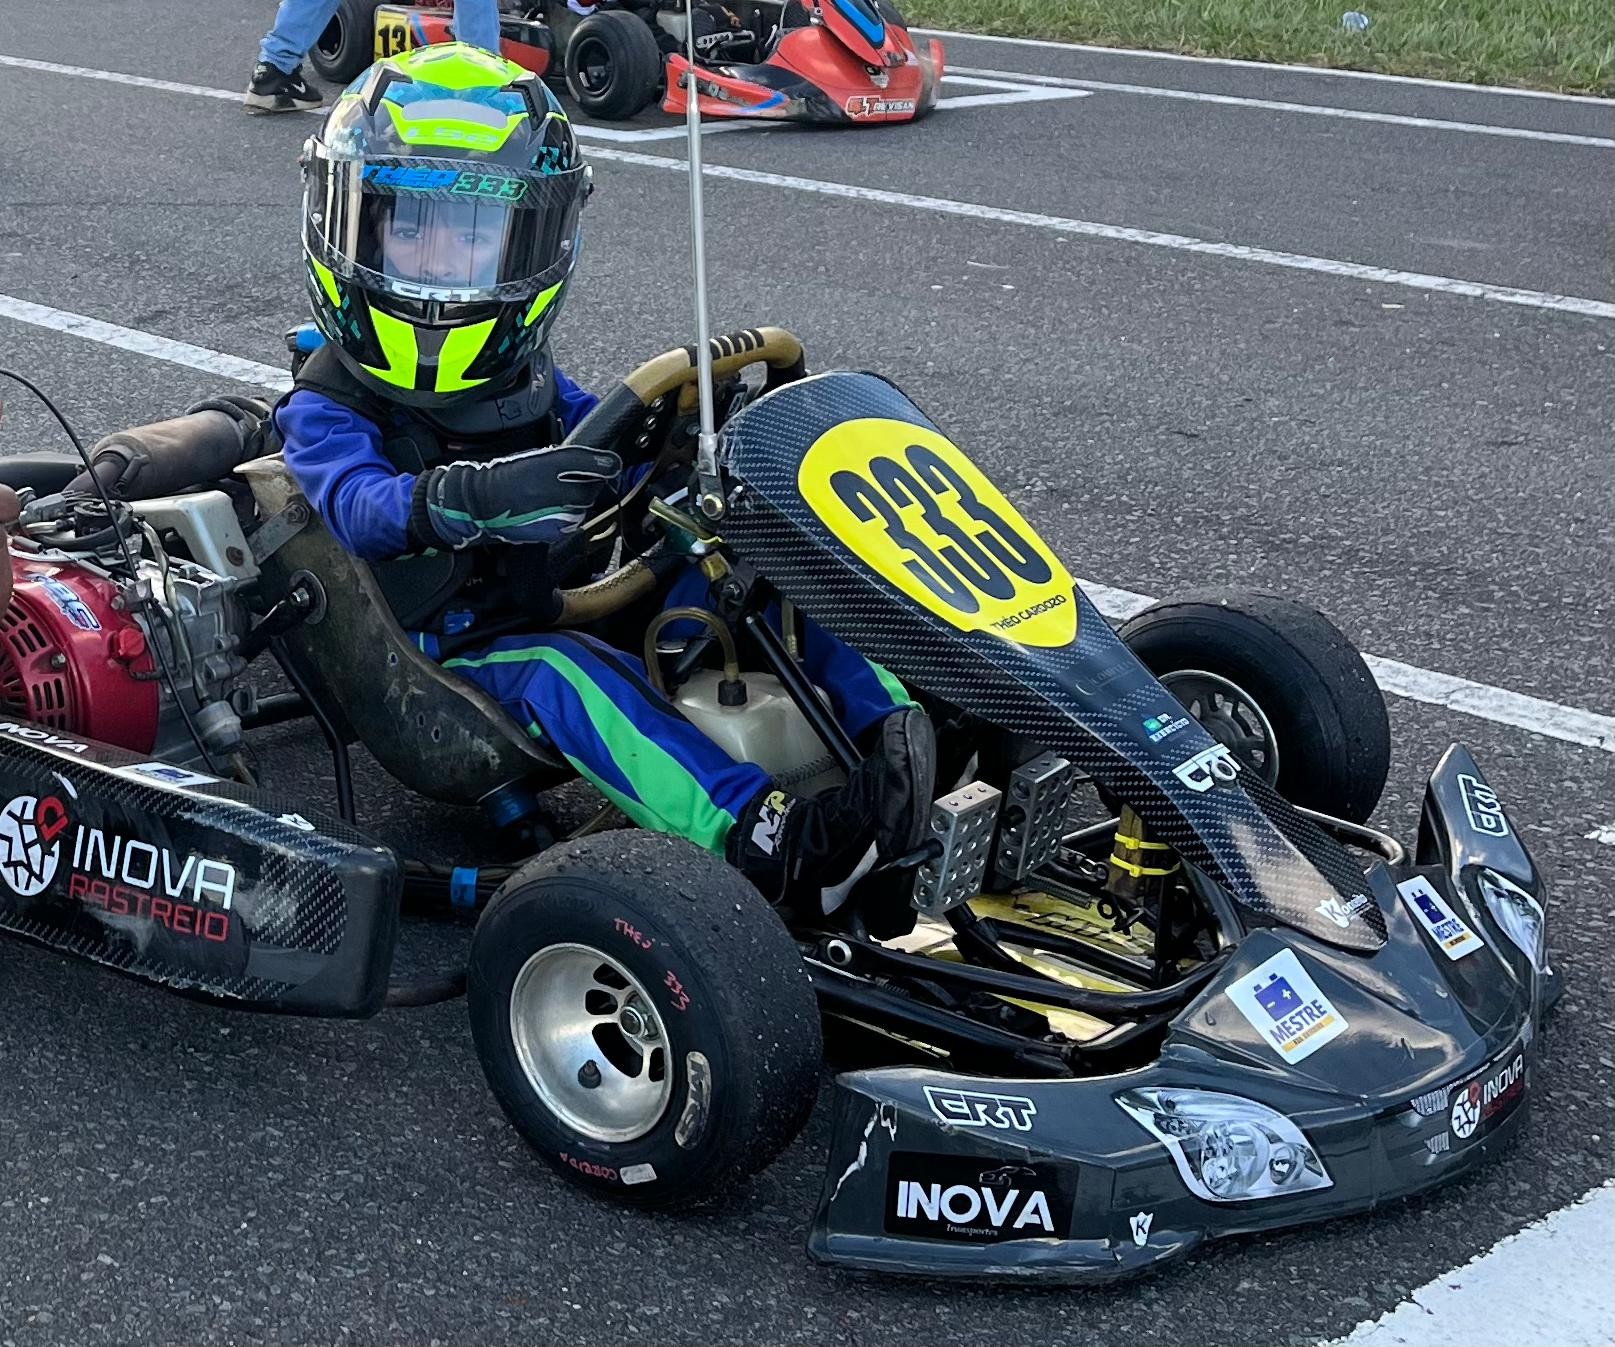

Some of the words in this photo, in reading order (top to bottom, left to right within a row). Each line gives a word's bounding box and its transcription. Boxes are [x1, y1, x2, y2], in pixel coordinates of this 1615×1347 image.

[376, 24, 407, 58] 13
[452, 172, 528, 200] 333
[392, 281, 479, 302] CRT
[830, 445, 1052, 613] 333
[1019, 595, 1067, 620] CARDOZO
[73, 825, 236, 910] INOVA
[69, 874, 230, 942] RASTREIO
[1269, 1000, 1327, 1044] MESTRE
[1483, 1054, 1524, 1105] INOVA
[897, 1180, 1055, 1232] INOVA
